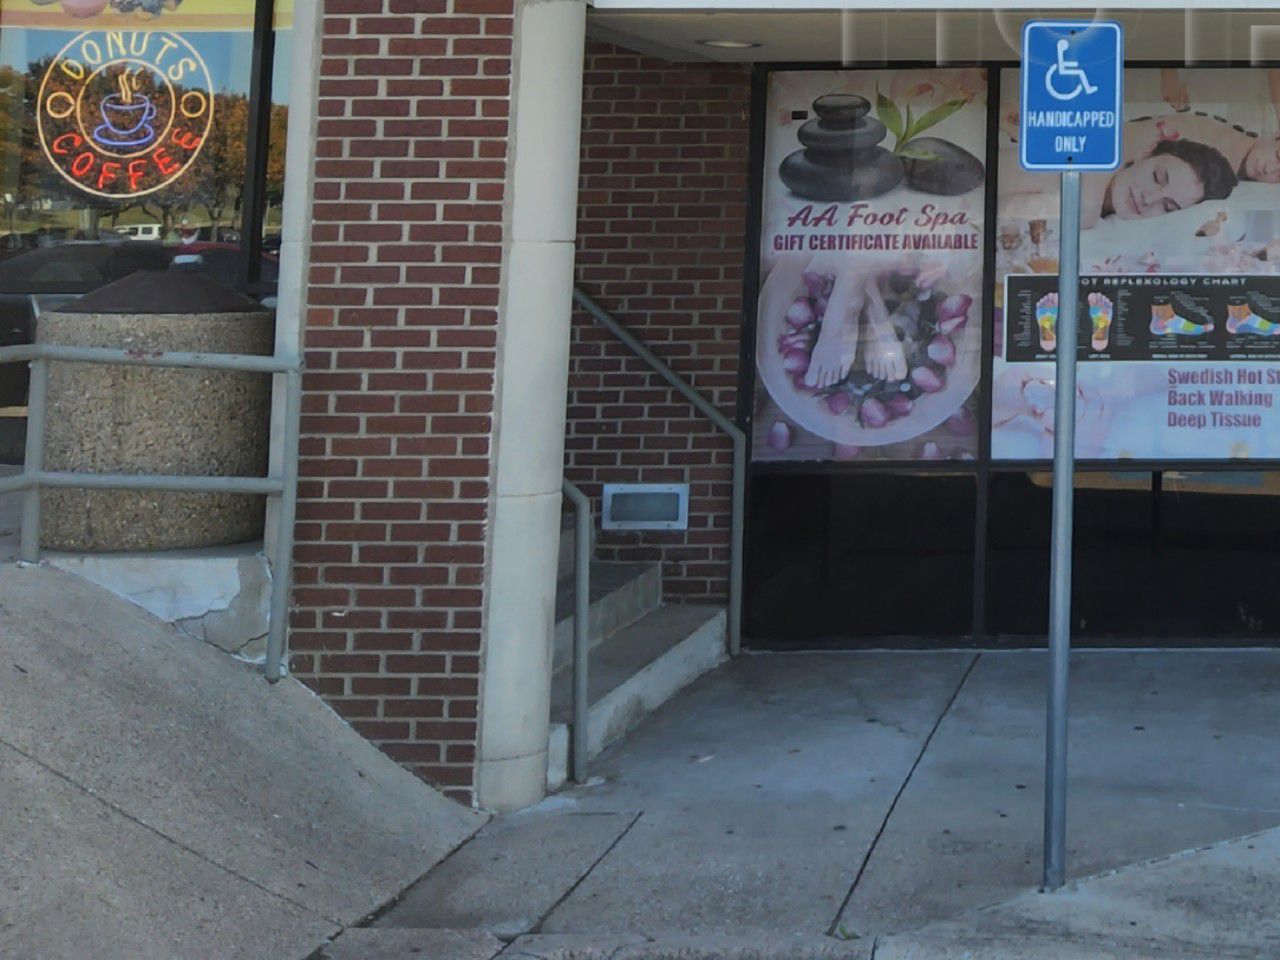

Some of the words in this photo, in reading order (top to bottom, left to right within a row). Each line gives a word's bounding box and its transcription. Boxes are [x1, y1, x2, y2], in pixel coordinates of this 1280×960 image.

[60, 31, 198, 81] DONUTS
[1027, 110, 1114, 128] HANDICAPPED
[1055, 136, 1087, 153] ONLY
[53, 127, 200, 189] COFFEE
[787, 204, 839, 228] AA
[847, 203, 909, 228] Foot
[914, 203, 968, 234] Spa
[773, 234, 804, 251] GIFT
[808, 234, 900, 251] CERTIFICATE
[902, 233, 979, 251] AVAILABLE
[1103, 277, 1197, 286] REFLEXOLOGY
[1202, 277, 1247, 286] CHART
[1168, 368, 1233, 385] Swedish
[1237, 368, 1263, 385] Hot
[1168, 390, 1205, 406] Back
[1210, 390, 1273, 407] Walking
[1168, 411, 1207, 429] Deep
[1210, 411, 1261, 428] Tissue
